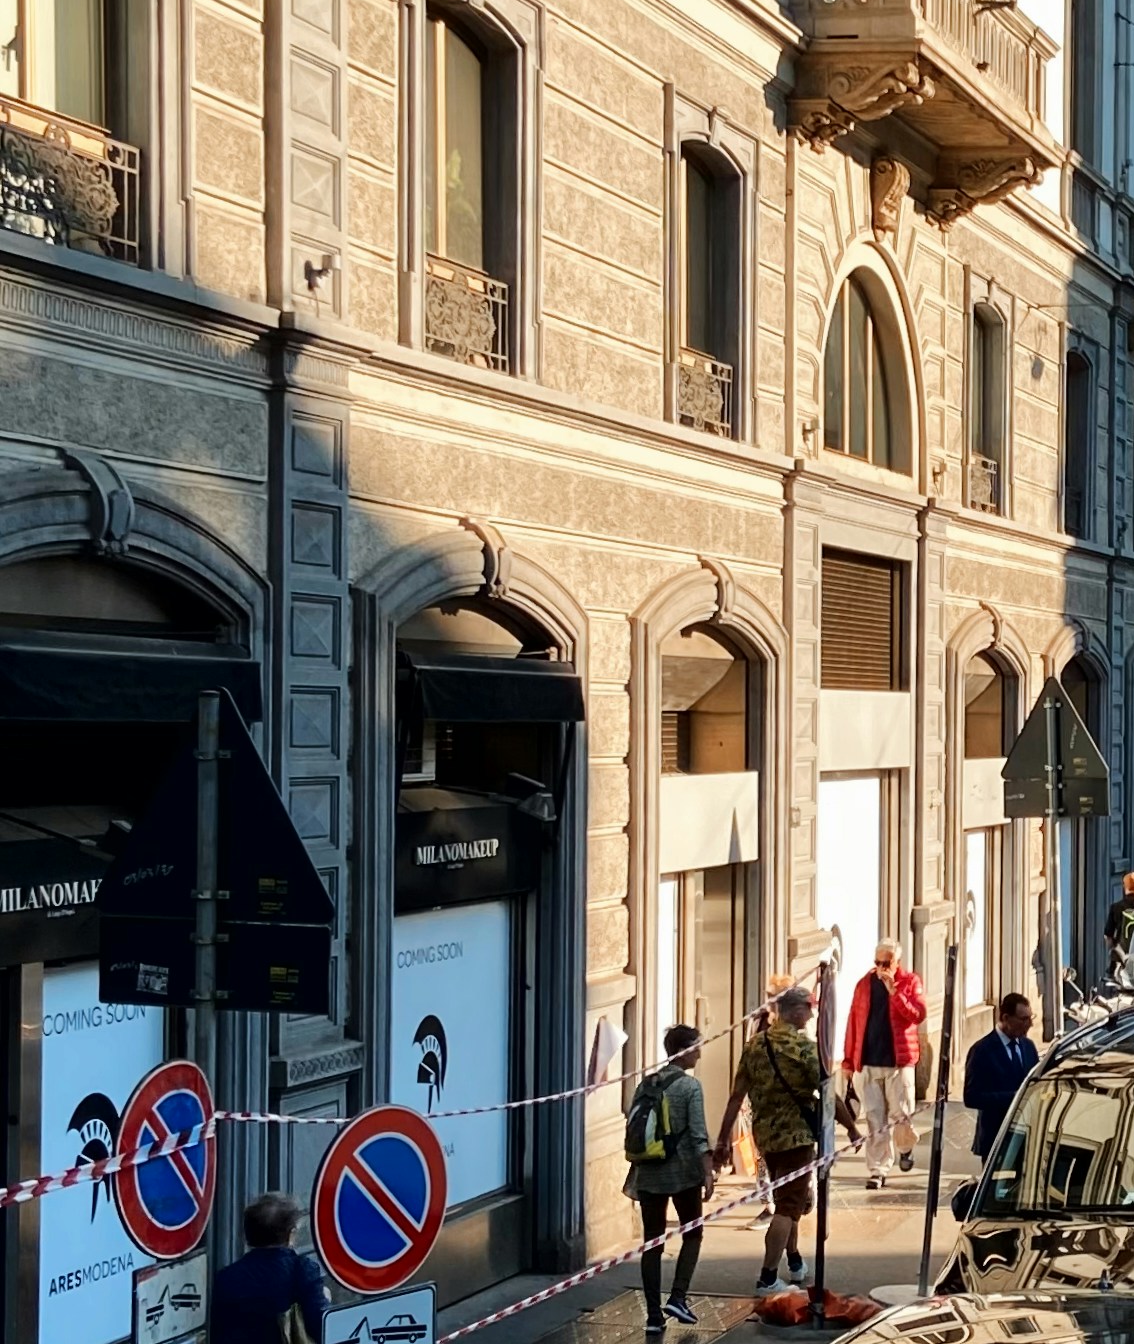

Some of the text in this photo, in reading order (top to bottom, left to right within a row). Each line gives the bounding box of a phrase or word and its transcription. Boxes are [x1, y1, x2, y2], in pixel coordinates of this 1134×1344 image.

[417, 839, 499, 865] MILANOMAKEUP
[397, 942, 463, 968] COMING SOON
[42, 1006, 103, 1037] COMING
[48, 1252, 134, 1297] ARESMODENA
